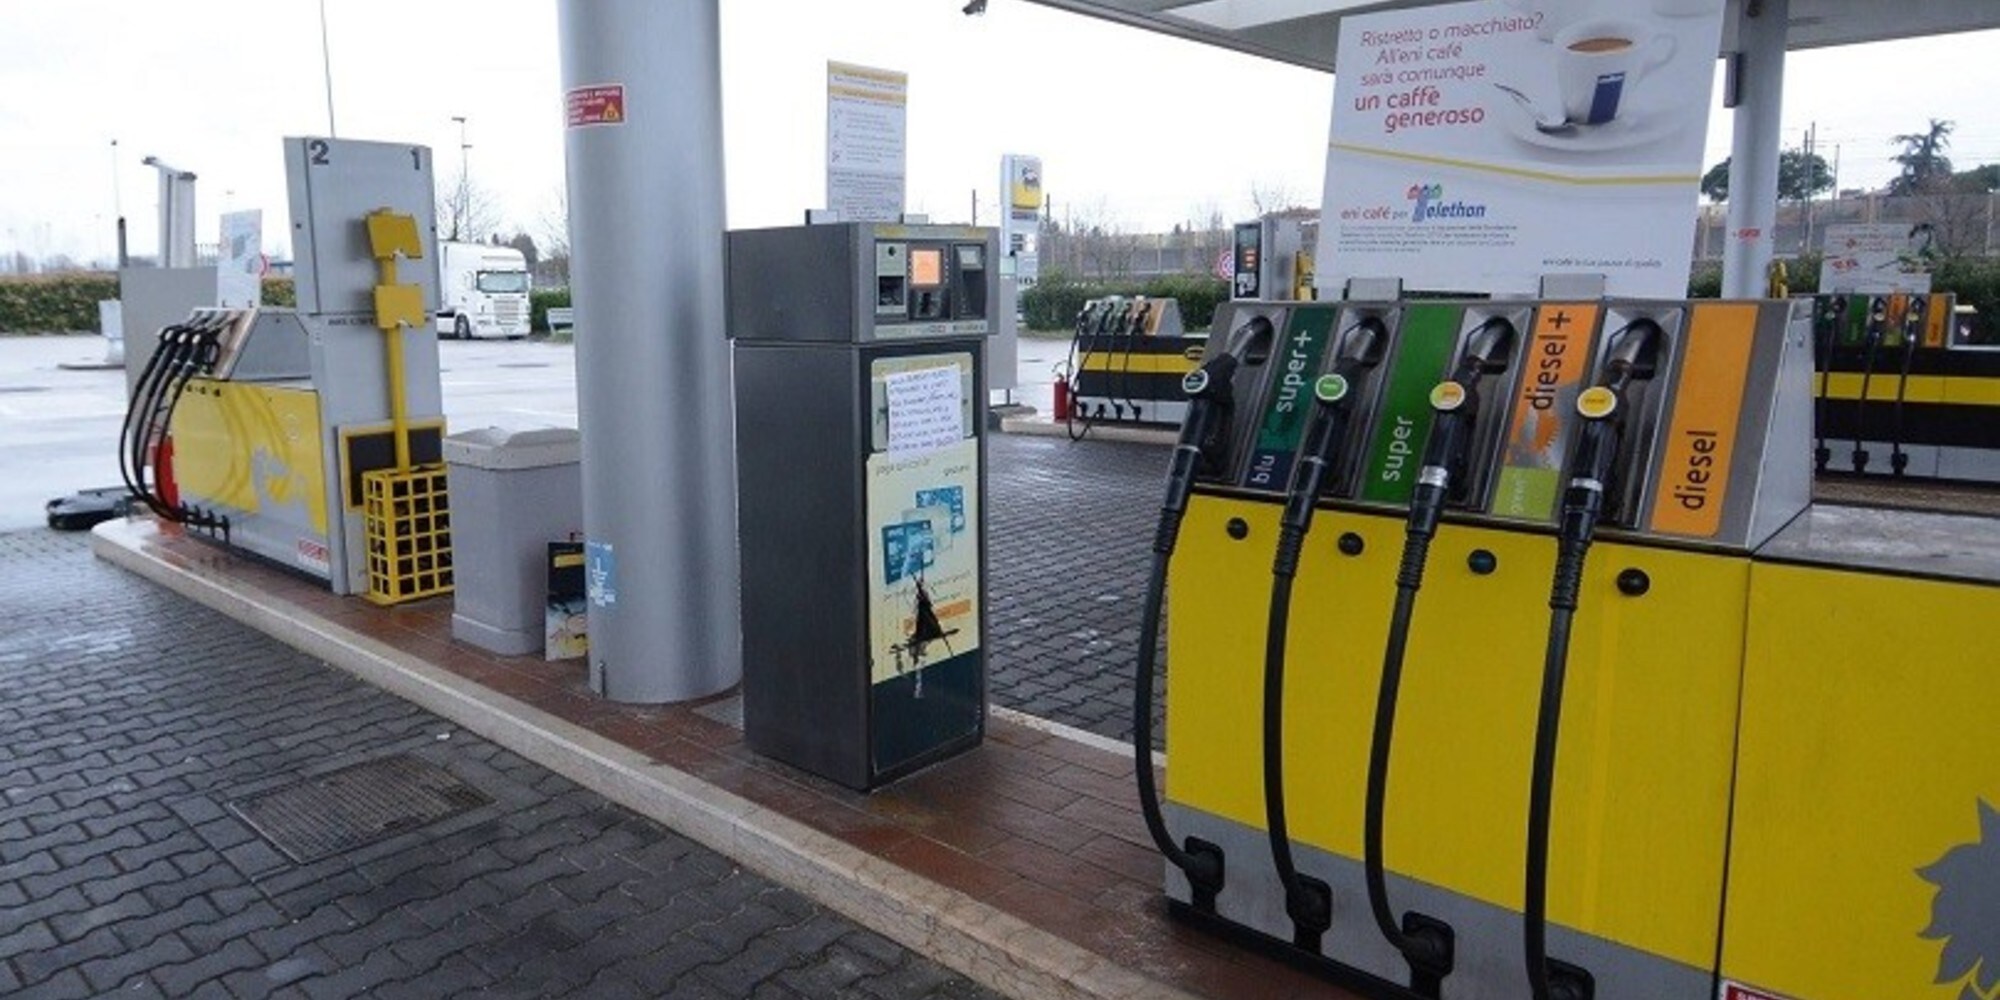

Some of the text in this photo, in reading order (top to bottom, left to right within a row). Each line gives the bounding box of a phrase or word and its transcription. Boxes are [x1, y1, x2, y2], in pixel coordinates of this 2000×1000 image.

[1360, 11, 1544, 47] Ristretto o macchiato?
[1427, 41, 1463, 61] café
[1360, 62, 1486, 87] sarà comunque
[1354, 94, 1380, 111] un
[1384, 106, 1485, 134] generoso
[309, 139, 330, 166] 2
[411, 148, 421, 171] 1
[1362, 205, 1391, 220] café
[1407, 184, 1486, 222] Telethon
[1382, 415, 1414, 482] super
[1251, 454, 1276, 484] blu
[1674, 430, 1718, 511] diesel
